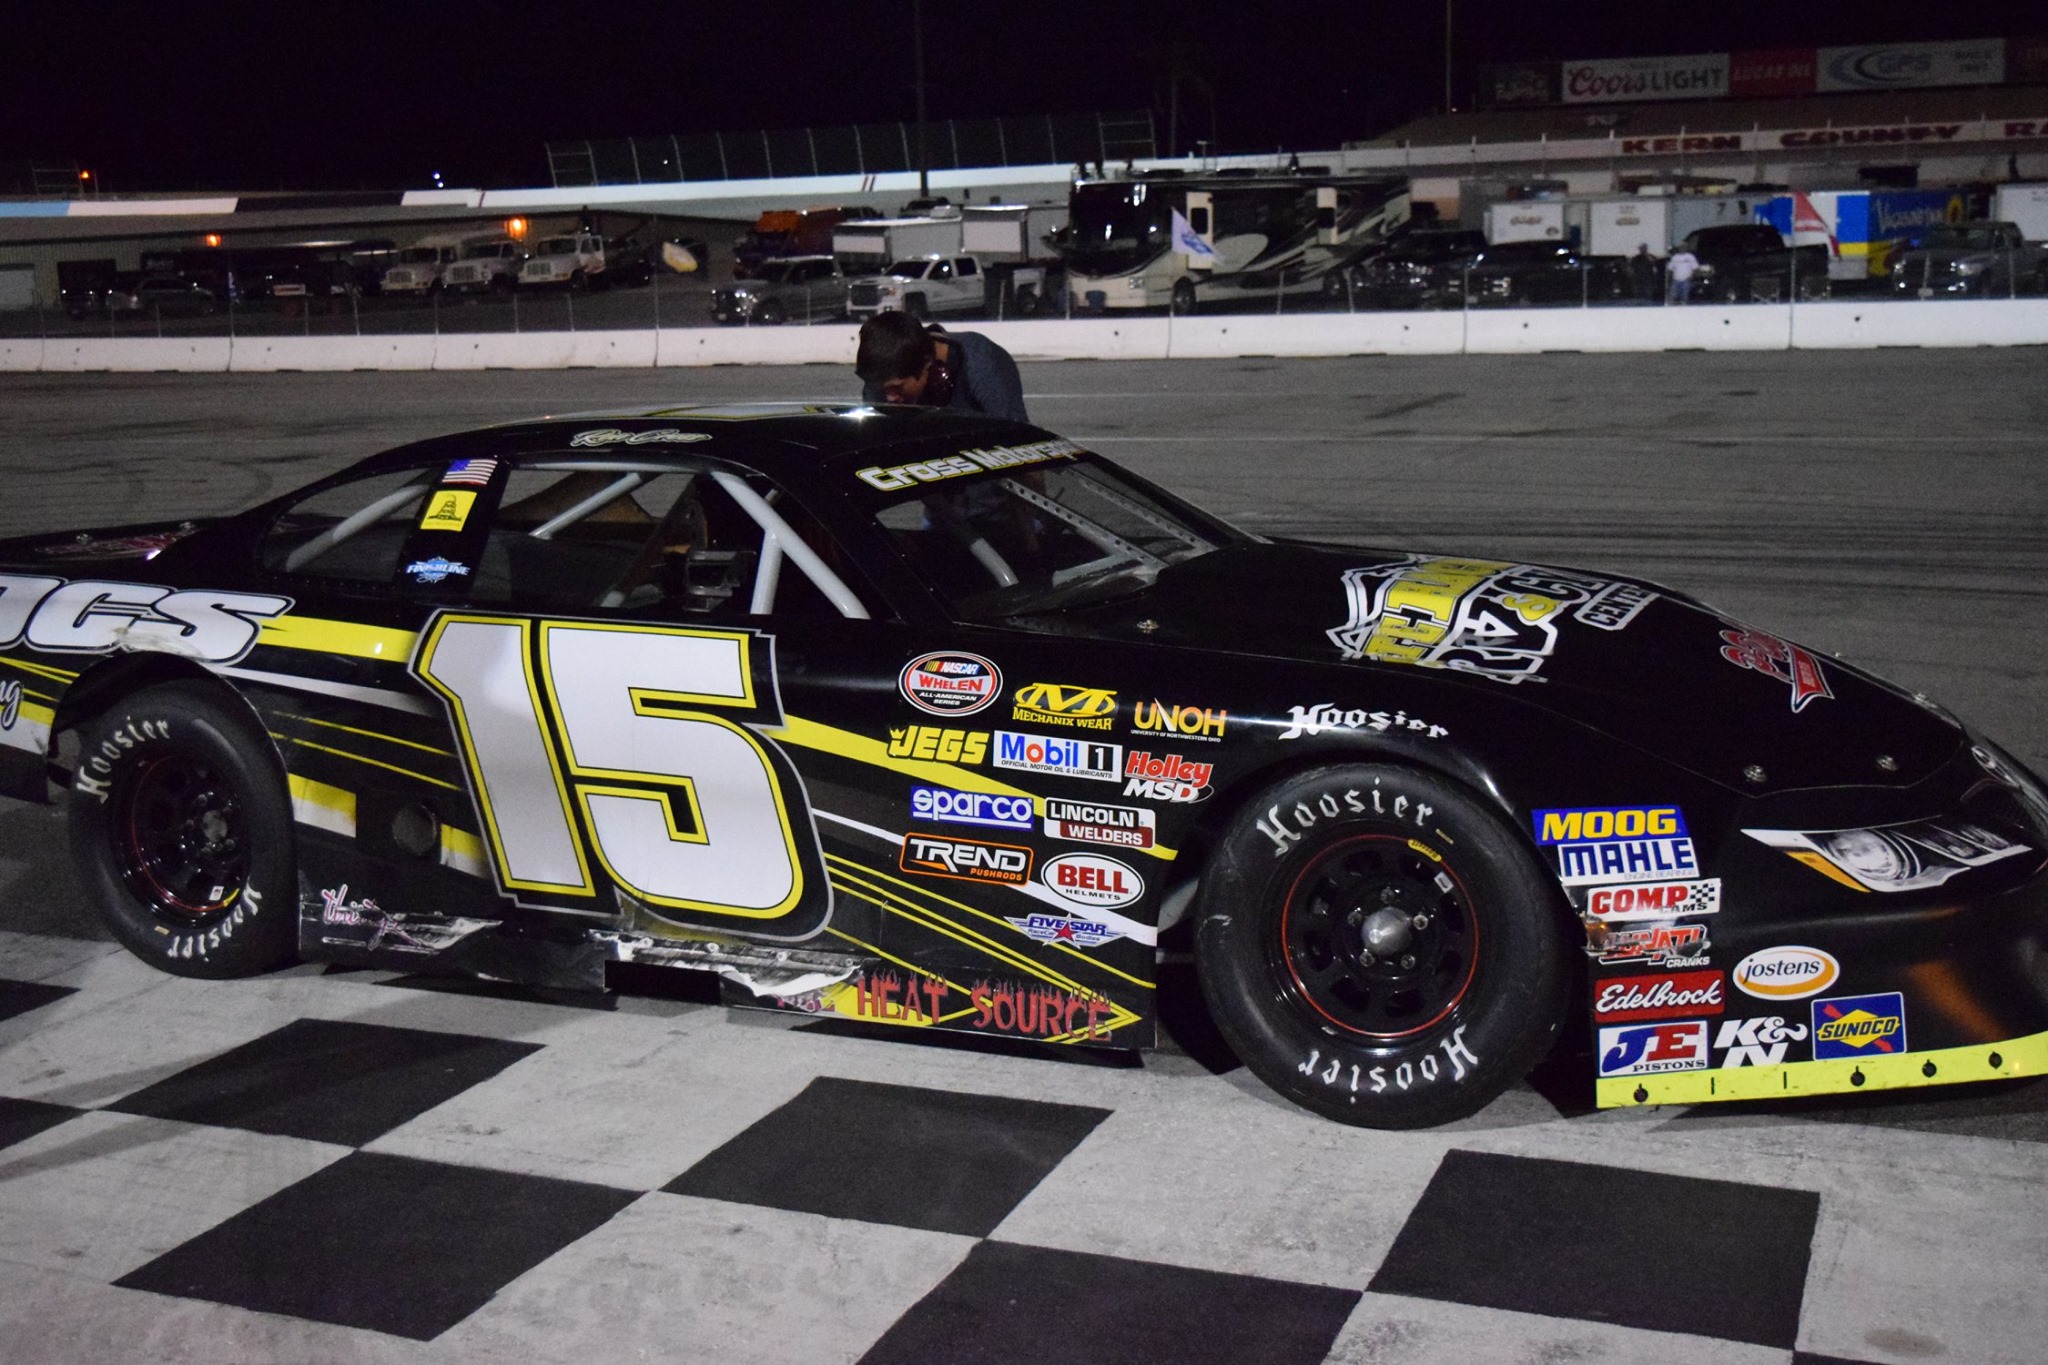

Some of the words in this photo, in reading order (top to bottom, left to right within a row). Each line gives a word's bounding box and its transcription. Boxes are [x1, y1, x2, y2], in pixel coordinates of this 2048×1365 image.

[1567, 66, 1646, 97] Coors
[1651, 68, 1724, 91] LIGHT
[1622, 135, 1741, 155] KERN
[1779, 125, 1963, 147] COUNTY
[856, 457, 983, 491] Cross
[940, 660, 981, 675] NASCAR
[918, 674, 984, 692] WHELEN
[919, 691, 977, 702] ALL-AMERICAN
[933, 698, 961, 706] SERIES
[1012, 706, 1074, 727] MECHANIX
[1076, 717, 1113, 731] WEAR
[1134, 698, 1227, 737] UNOH
[1278, 703, 1449, 740] Hoosier
[888, 725, 990, 764] JEGS
[1130, 729, 1160, 737] UNIVERSITY
[1166, 733, 1208, 742] NORTHWESTERN
[75, 715, 170, 804] Hoosier
[1001, 734, 1079, 768] Mobil
[413, 612, 812, 926] 15
[1001, 759, 1028, 769] OFFICIAL
[1030, 763, 1053, 772] MOTOR
[1054, 766, 1064, 774] OIL
[1072, 769, 1113, 779] LUBRICANTS
[1124, 750, 1214, 789] Holley
[912, 788, 1033, 822] sparco
[1122, 778, 1200, 803] MSD
[1050, 802, 1135, 828] LINCOLN
[1256, 776, 1434, 857] Hoosier
[1541, 809, 1678, 841] MOOG
[1068, 825, 1143, 846] WELDERS
[909, 838, 1027, 873] TREND
[1561, 839, 1695, 877] MAHLE
[970, 867, 1023, 882] PUSHRODS
[1057, 863, 1130, 895] BELL
[1065, 888, 1121, 901] HELMETS
[1591, 885, 1688, 914] COMP
[1659, 901, 1708, 915] CAMS
[168, 876, 263, 962] Hoosier
[1028, 916, 1065, 929] FIVE
[1069, 921, 1107, 936] STAR
[1666, 956, 1711, 968] CRANKS
[1742, 957, 1820, 985] jostens
[856, 968, 948, 1024] HEAT
[970, 978, 1112, 1042] SOURCE
[1596, 979, 1722, 1013] Edelbrock
[1817, 1016, 1897, 1041] SUNOCO
[1601, 1023, 1701, 1074] JE
[1298, 1025, 1479, 1104] Hoosier
[1633, 1059, 1706, 1073] PISTONS
